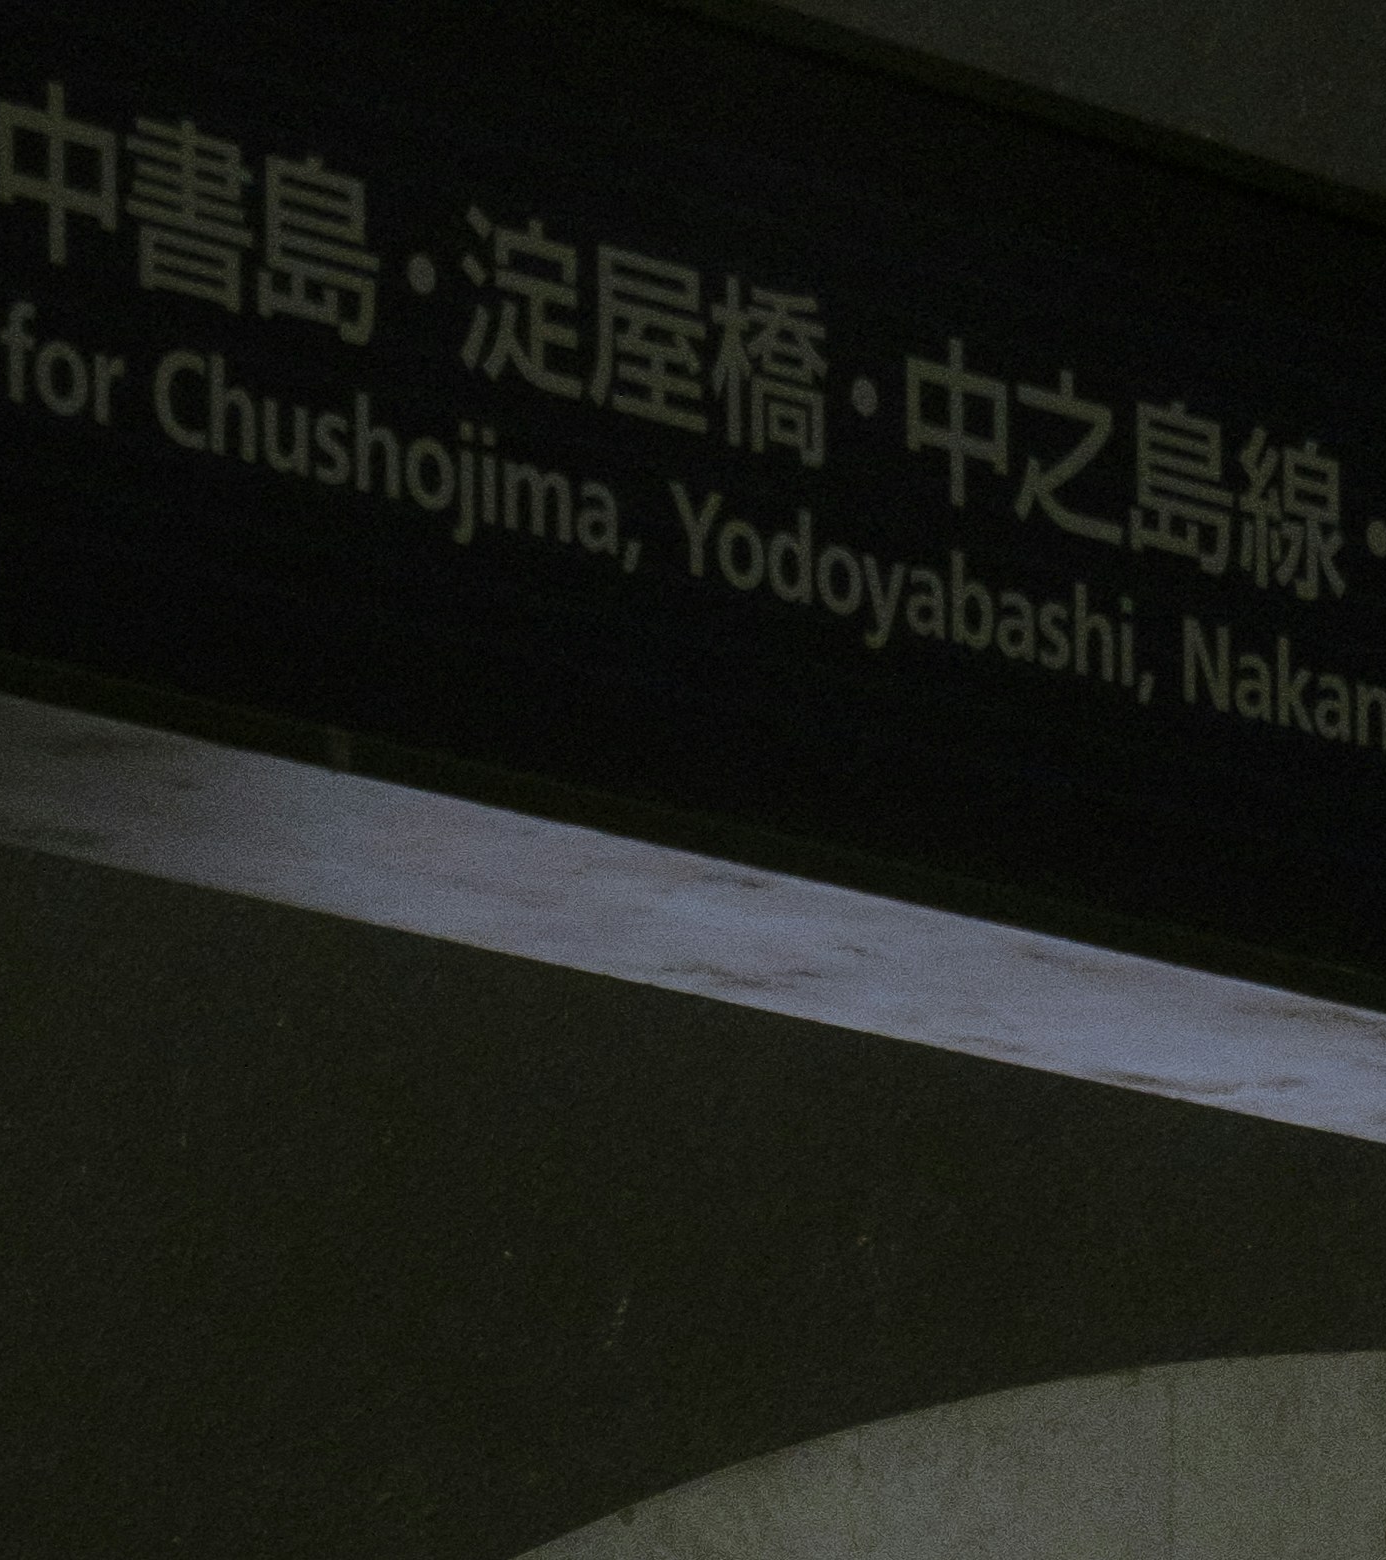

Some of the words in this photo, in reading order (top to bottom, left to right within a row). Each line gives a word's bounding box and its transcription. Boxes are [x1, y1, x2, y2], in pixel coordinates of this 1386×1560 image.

[0, 299, 126, 428] for
[151, 346, 644, 576] Chushojima,
[668, 480, 1156, 706] Yodoyabashi,
